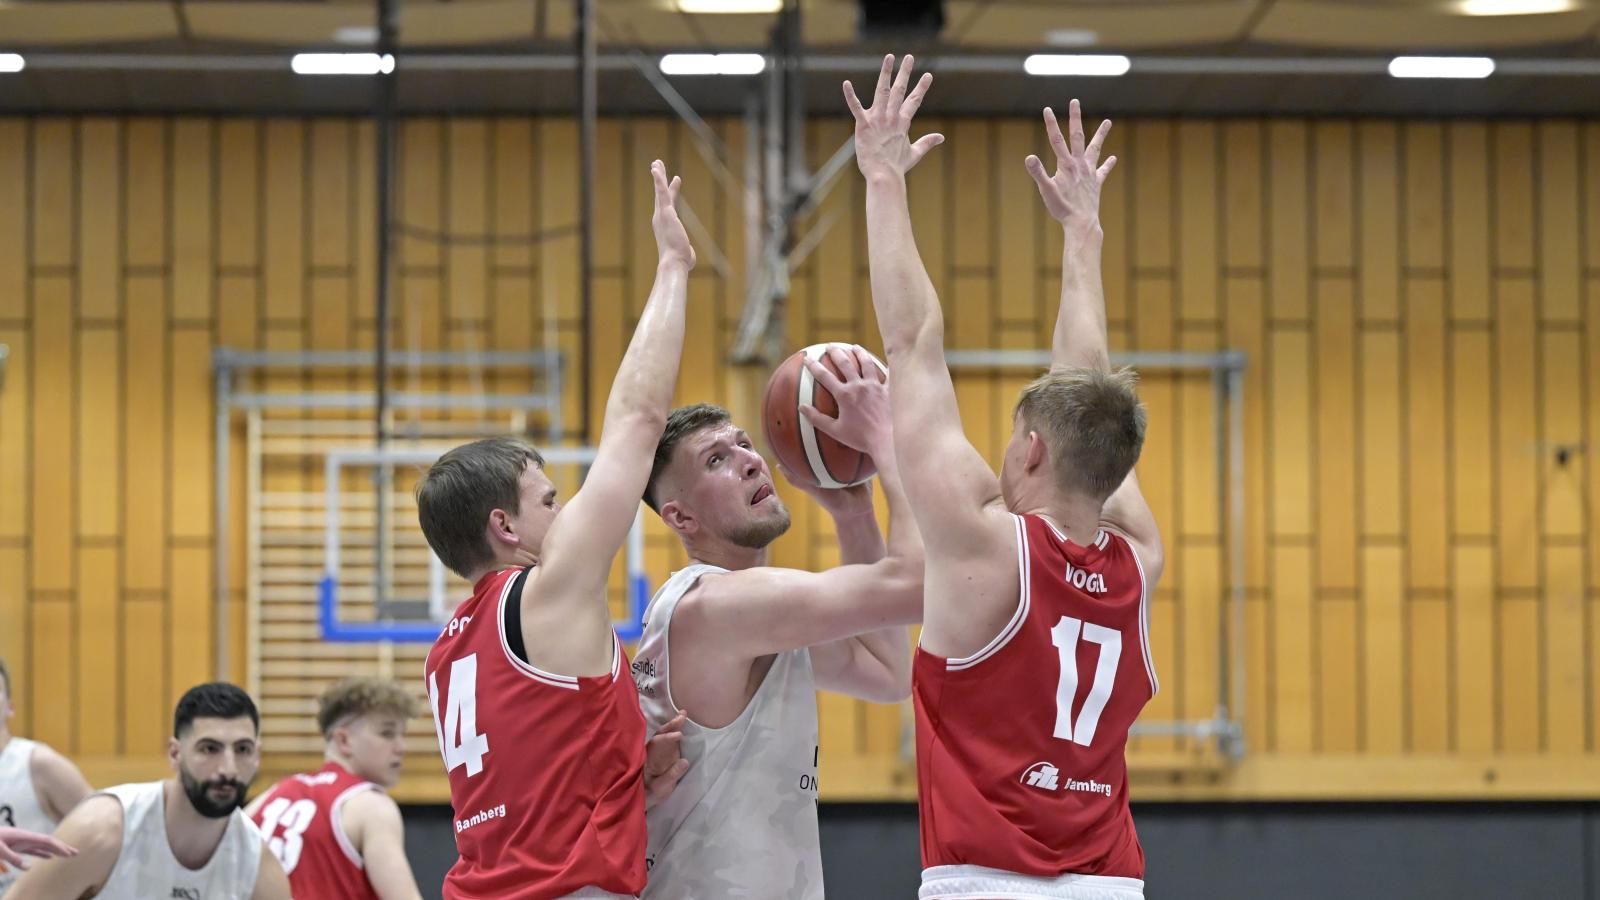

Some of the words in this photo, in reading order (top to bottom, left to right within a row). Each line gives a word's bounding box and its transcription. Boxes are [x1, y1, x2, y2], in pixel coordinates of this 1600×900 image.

[429, 652, 489, 778] 14
[1051, 615, 1122, 747] 17
[260, 797, 317, 875] 13
[456, 804, 506, 833] Bamberg
